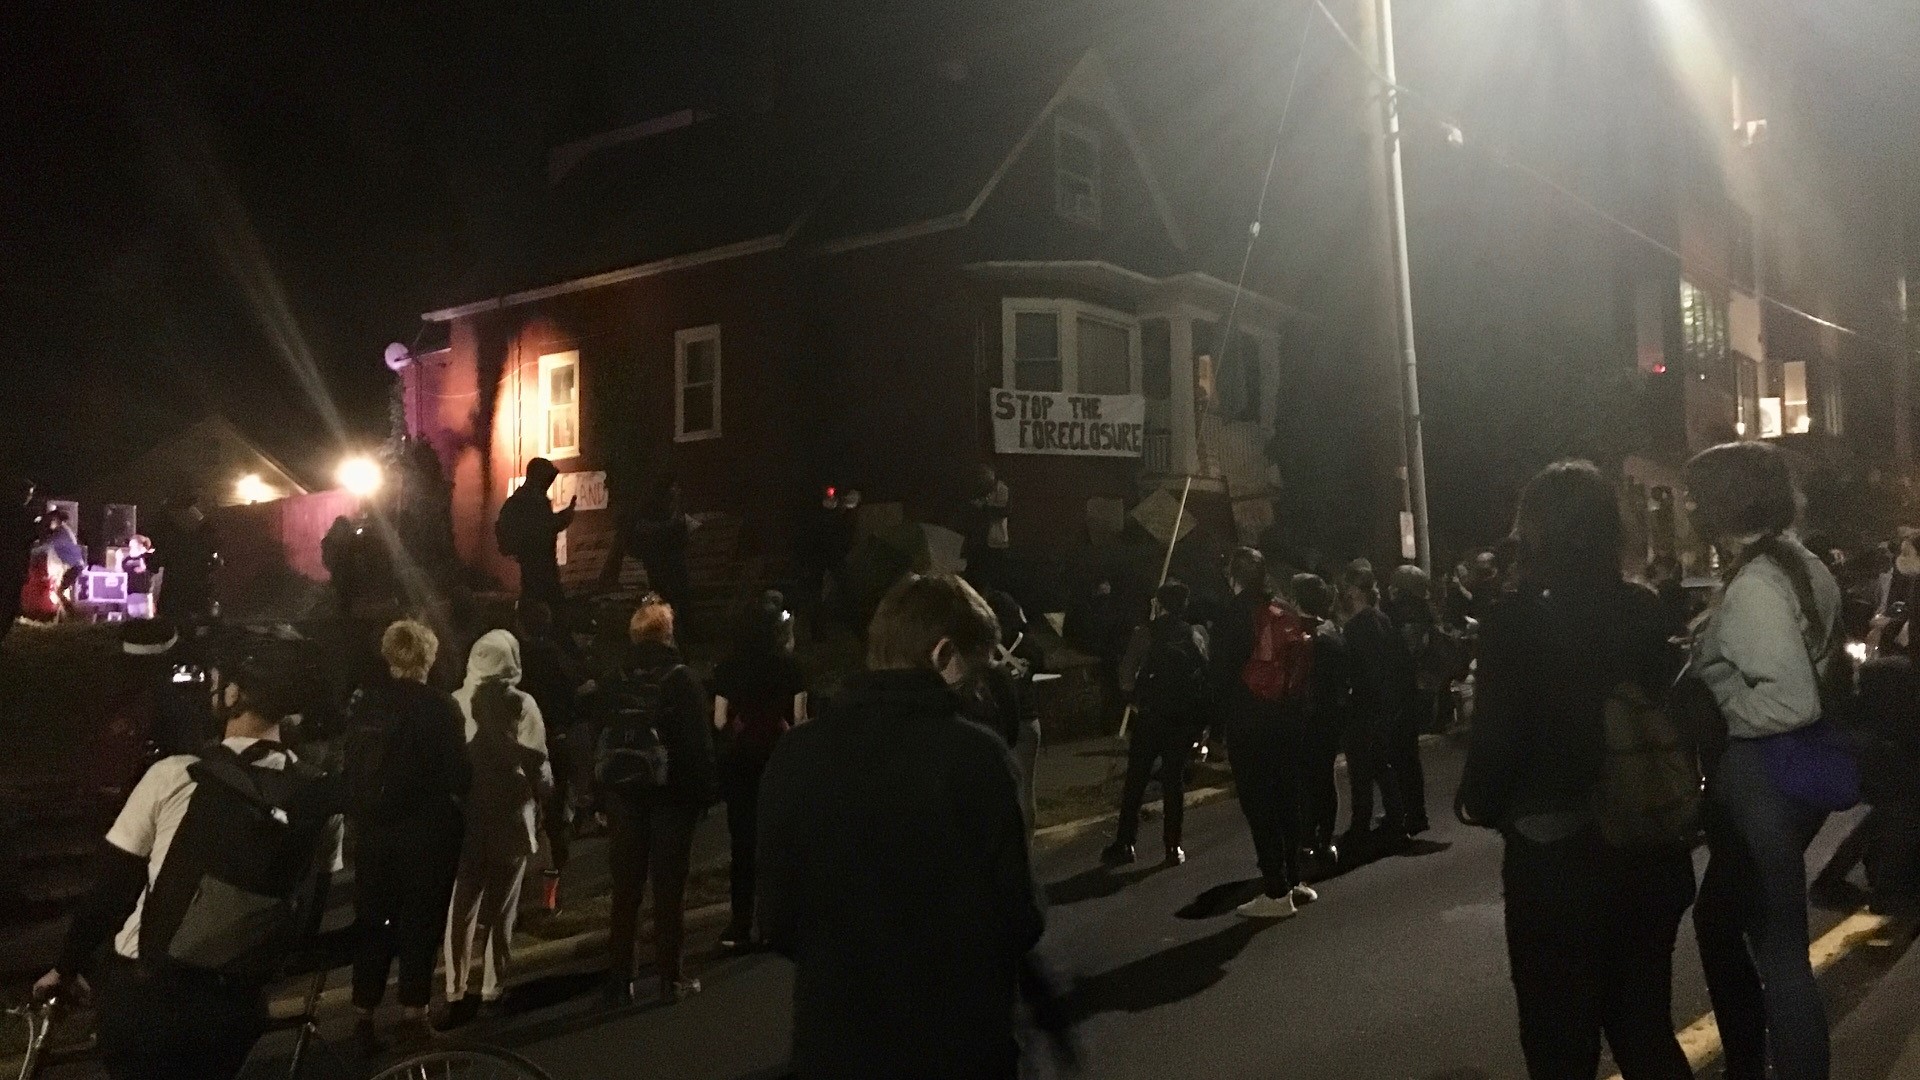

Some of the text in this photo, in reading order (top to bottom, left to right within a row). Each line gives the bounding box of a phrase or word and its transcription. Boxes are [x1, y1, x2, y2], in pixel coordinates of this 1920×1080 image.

[995, 392, 1102, 420] STOP THE
[1019, 420, 1142, 451] FORECLOSURE
